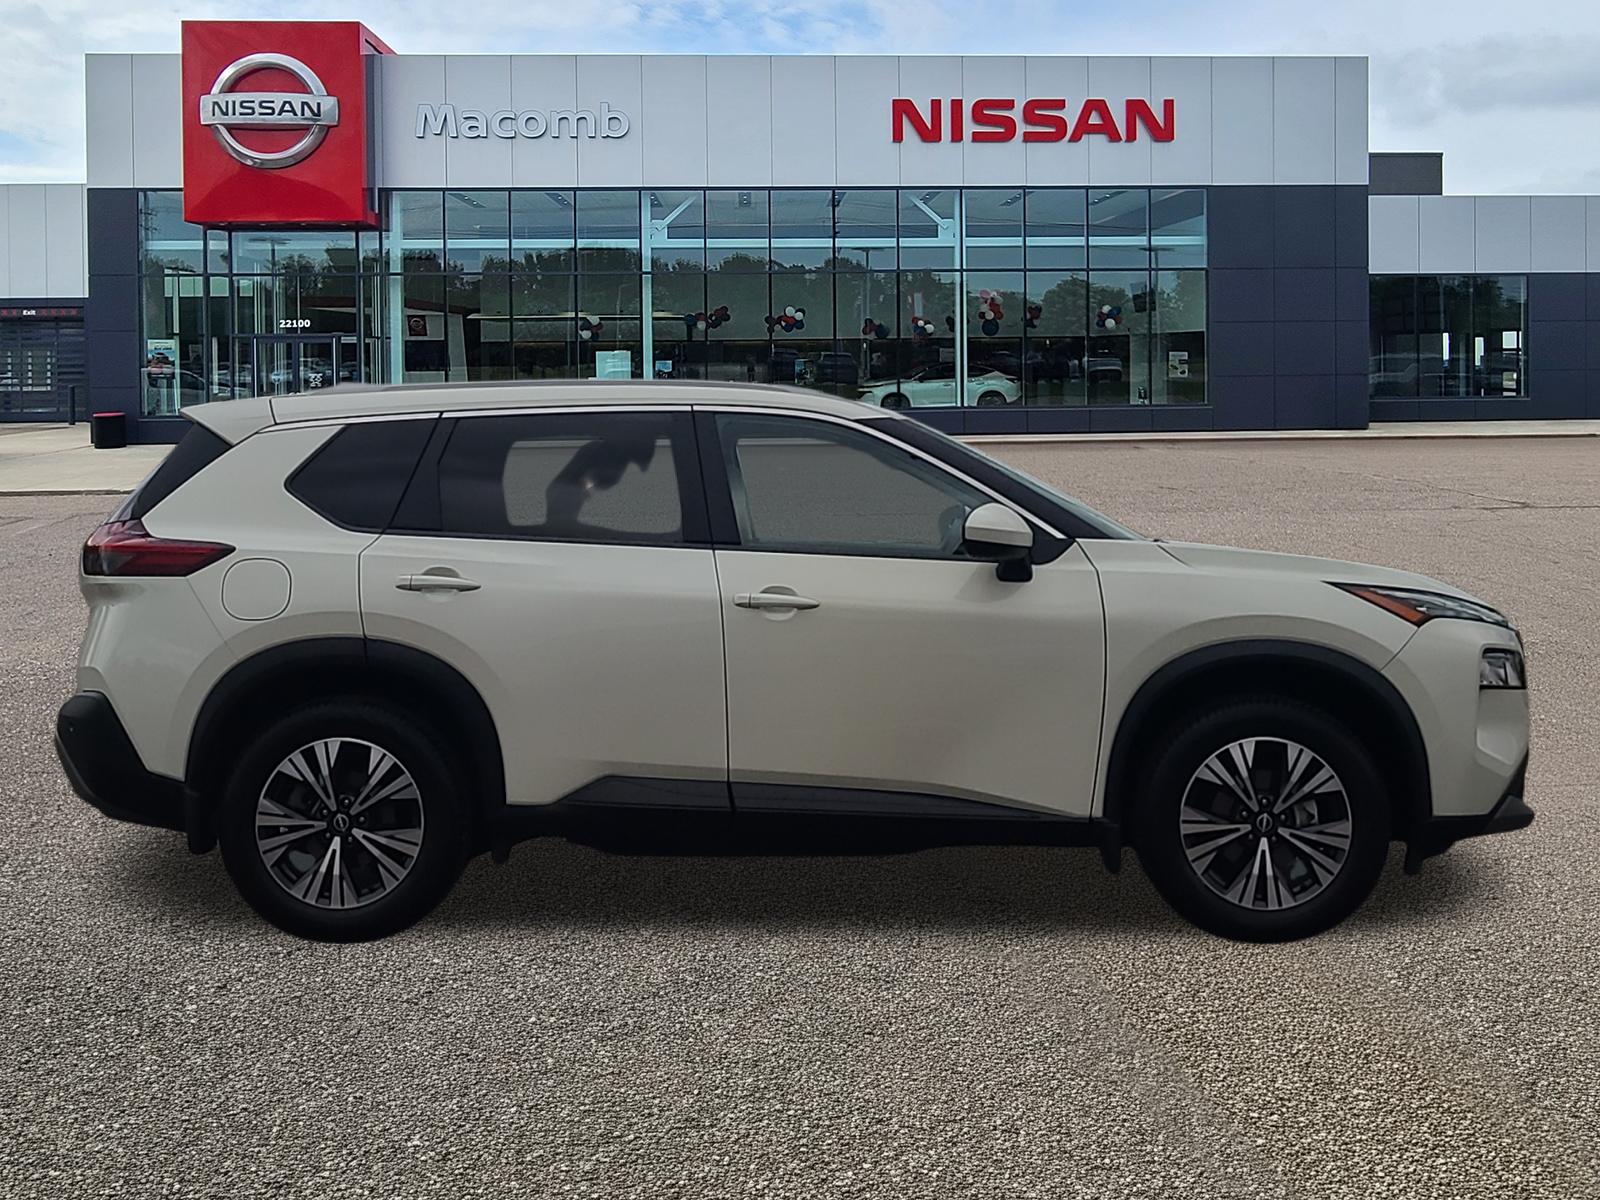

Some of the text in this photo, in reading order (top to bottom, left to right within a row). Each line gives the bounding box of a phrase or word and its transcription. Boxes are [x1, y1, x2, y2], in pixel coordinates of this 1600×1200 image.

[211, 100, 321, 117] NISSAN
[416, 102, 630, 139] Macomb
[892, 98, 1175, 143] NISSAN
[279, 319, 311, 328] 22100
